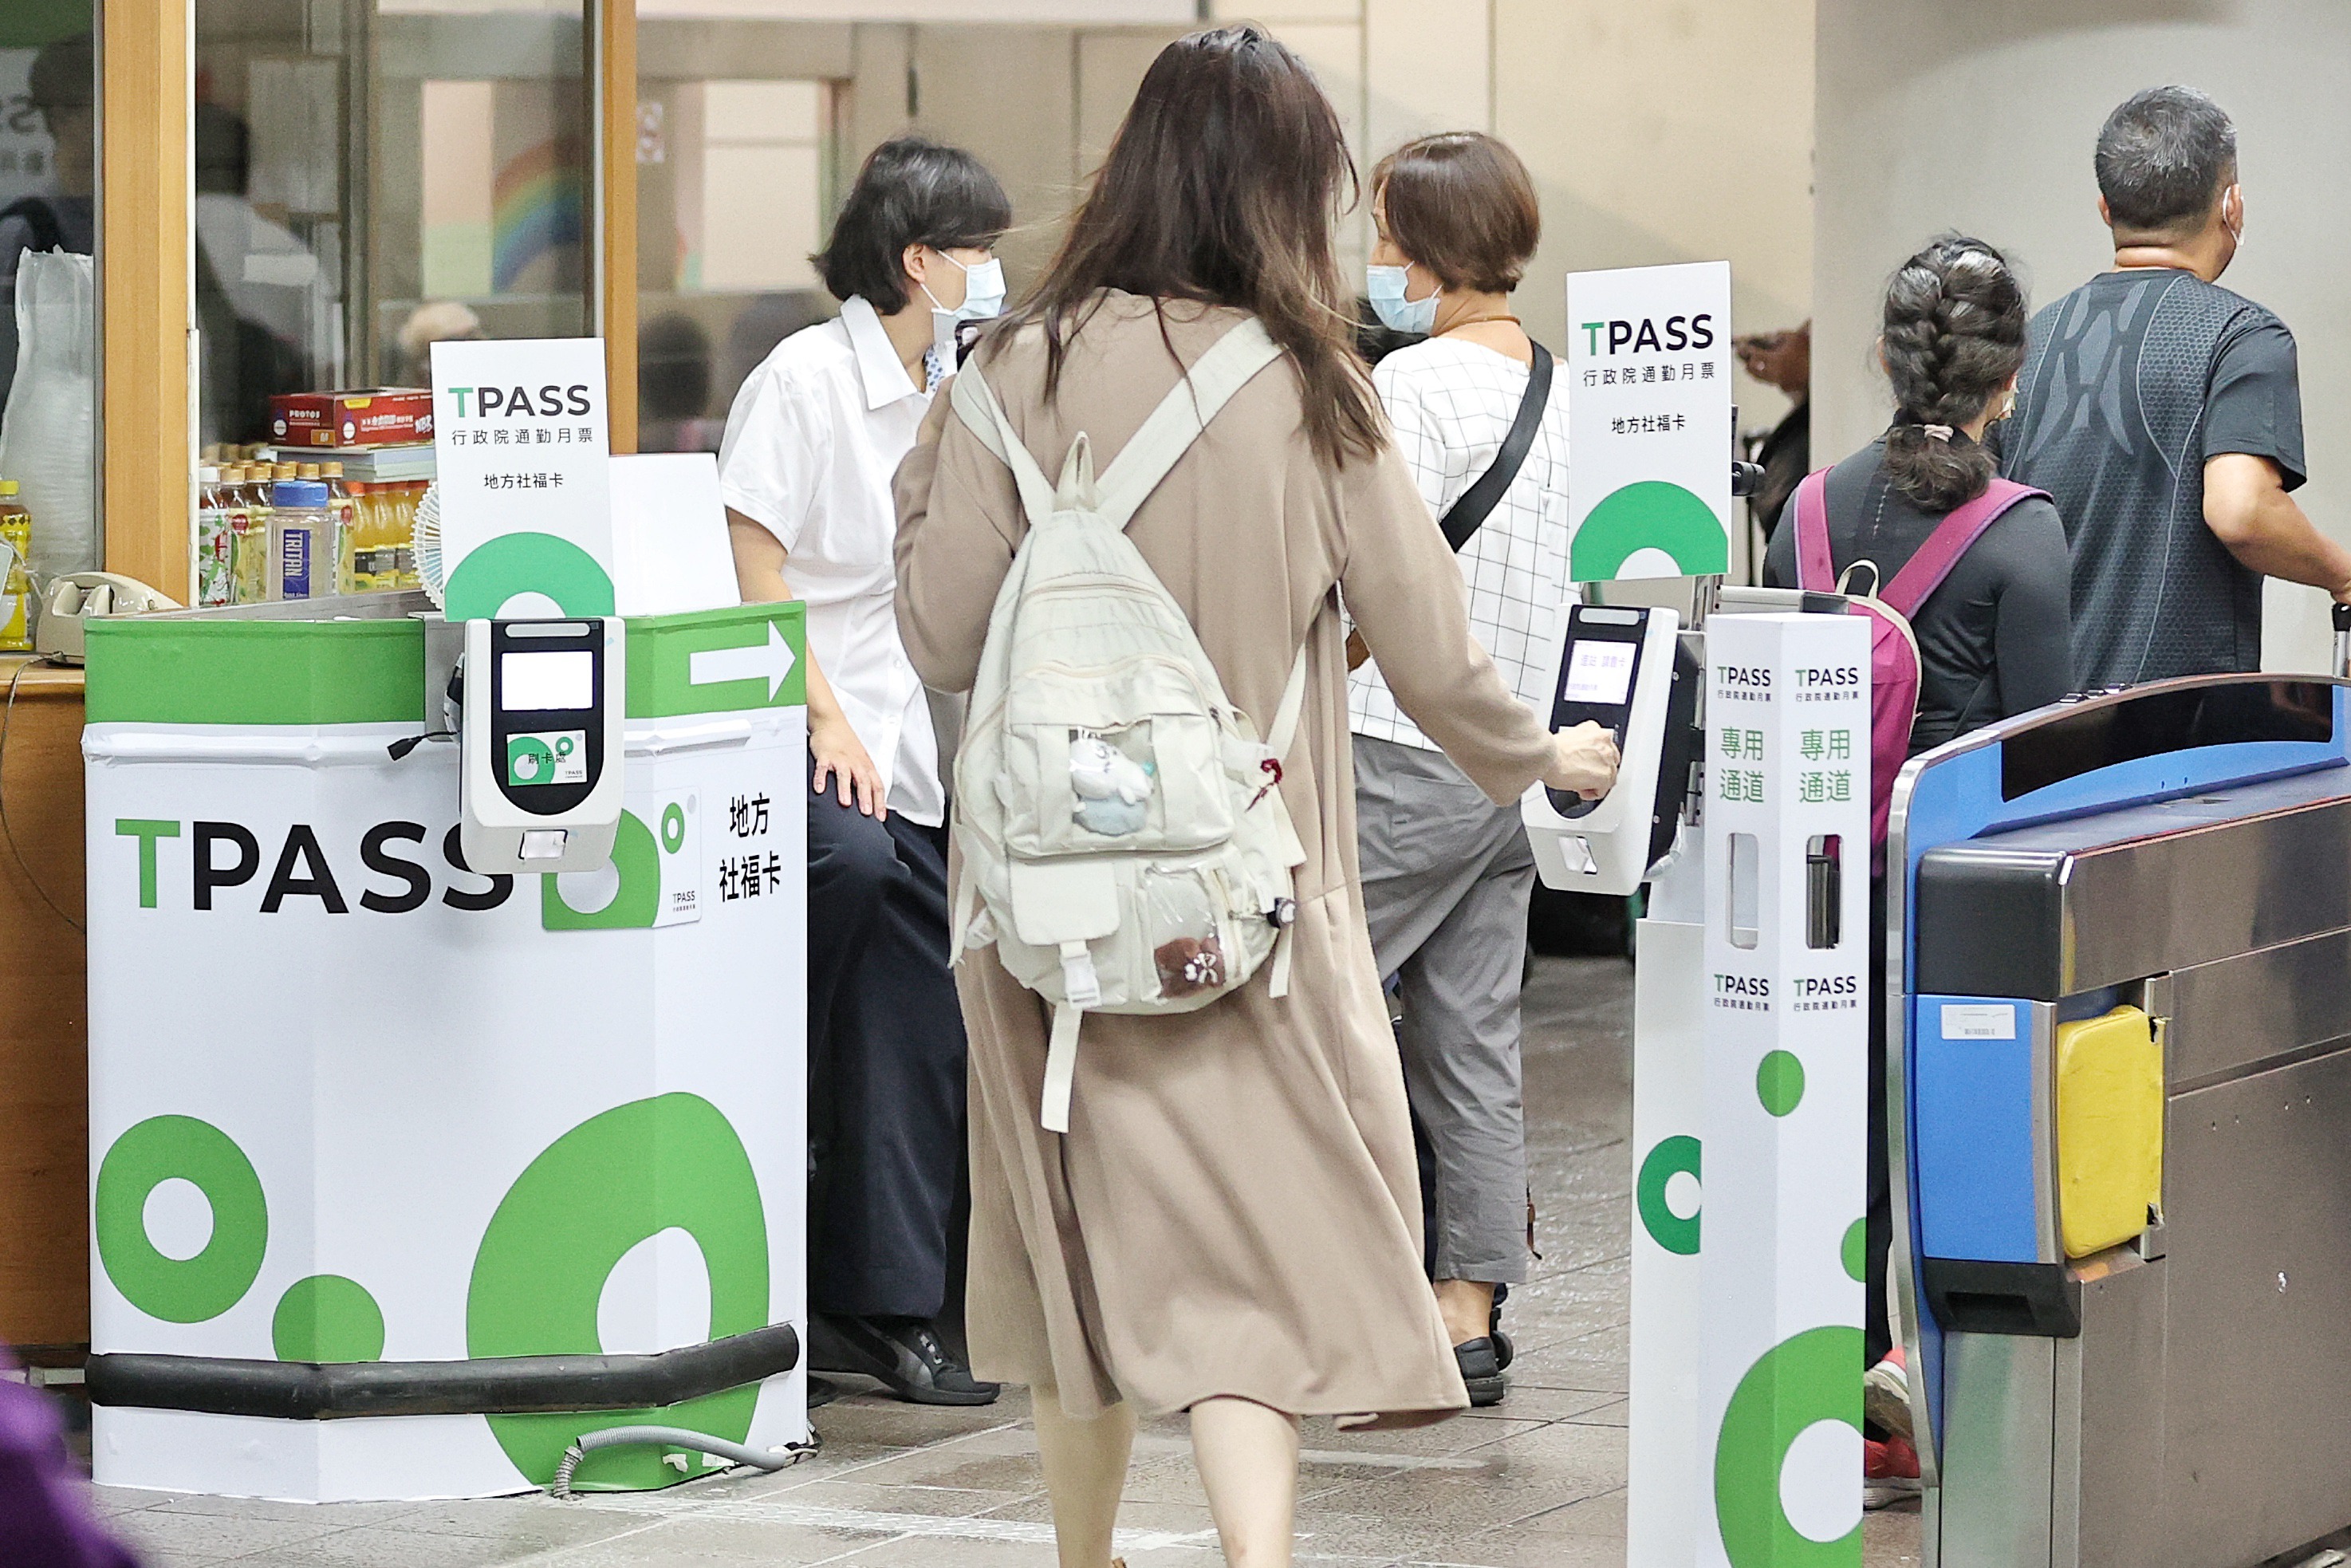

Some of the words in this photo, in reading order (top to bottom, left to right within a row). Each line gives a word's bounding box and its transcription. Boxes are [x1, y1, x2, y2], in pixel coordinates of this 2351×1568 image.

[1581, 313, 1714, 357] TPASS
[1582, 361, 1715, 388] 行政院通勤月票
[447, 384, 591, 418] TPASS
[451, 427, 593, 446] 行政院通勤月票
[1611, 413, 1686, 435] 地方社福卡
[483, 472, 564, 490] 地方社福卡
[285, 532, 303, 576] TRITAN
[1717, 666, 1771, 687] TPASS
[1794, 667, 1859, 687] TPASS
[1720, 726, 1763, 761] 專用
[1800, 729, 1850, 761] 專用
[1720, 768, 1764, 803] 通道
[1799, 769, 1852, 803] 通道
[730, 791, 770, 838] 地方
[115, 818, 514, 914] TPASS
[719, 849, 782, 903] 社福卡
[672, 890, 695, 904] TPASS
[1713, 973, 1770, 997] TPASS
[1793, 975, 1857, 997] TPASS
